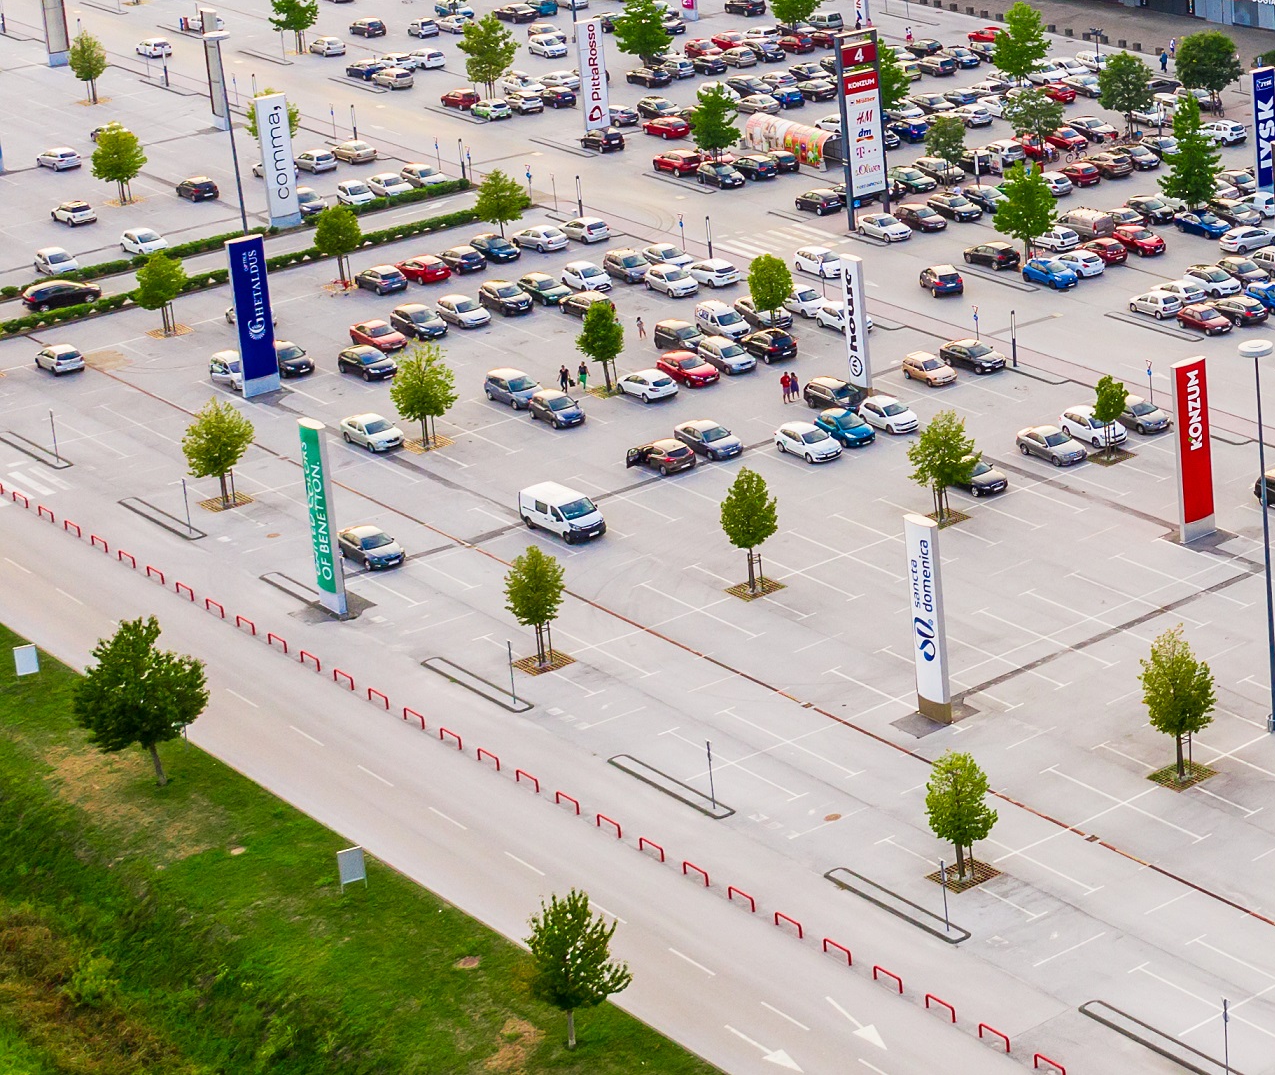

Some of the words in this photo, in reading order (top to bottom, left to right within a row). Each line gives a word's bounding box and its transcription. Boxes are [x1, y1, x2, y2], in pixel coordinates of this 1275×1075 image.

[588, 23, 602, 102] PittaRosso
[847, 77, 876, 90] KONZUM
[854, 47, 865, 63] 4
[268, 105, 290, 200] comma,
[858, 128, 872, 138] dm
[845, 268, 858, 353] house
[1186, 369, 1203, 451] KONZUM
[320, 557, 333, 581] OF
[910, 559, 921, 609] sancta
[918, 539, 933, 613] domenica
